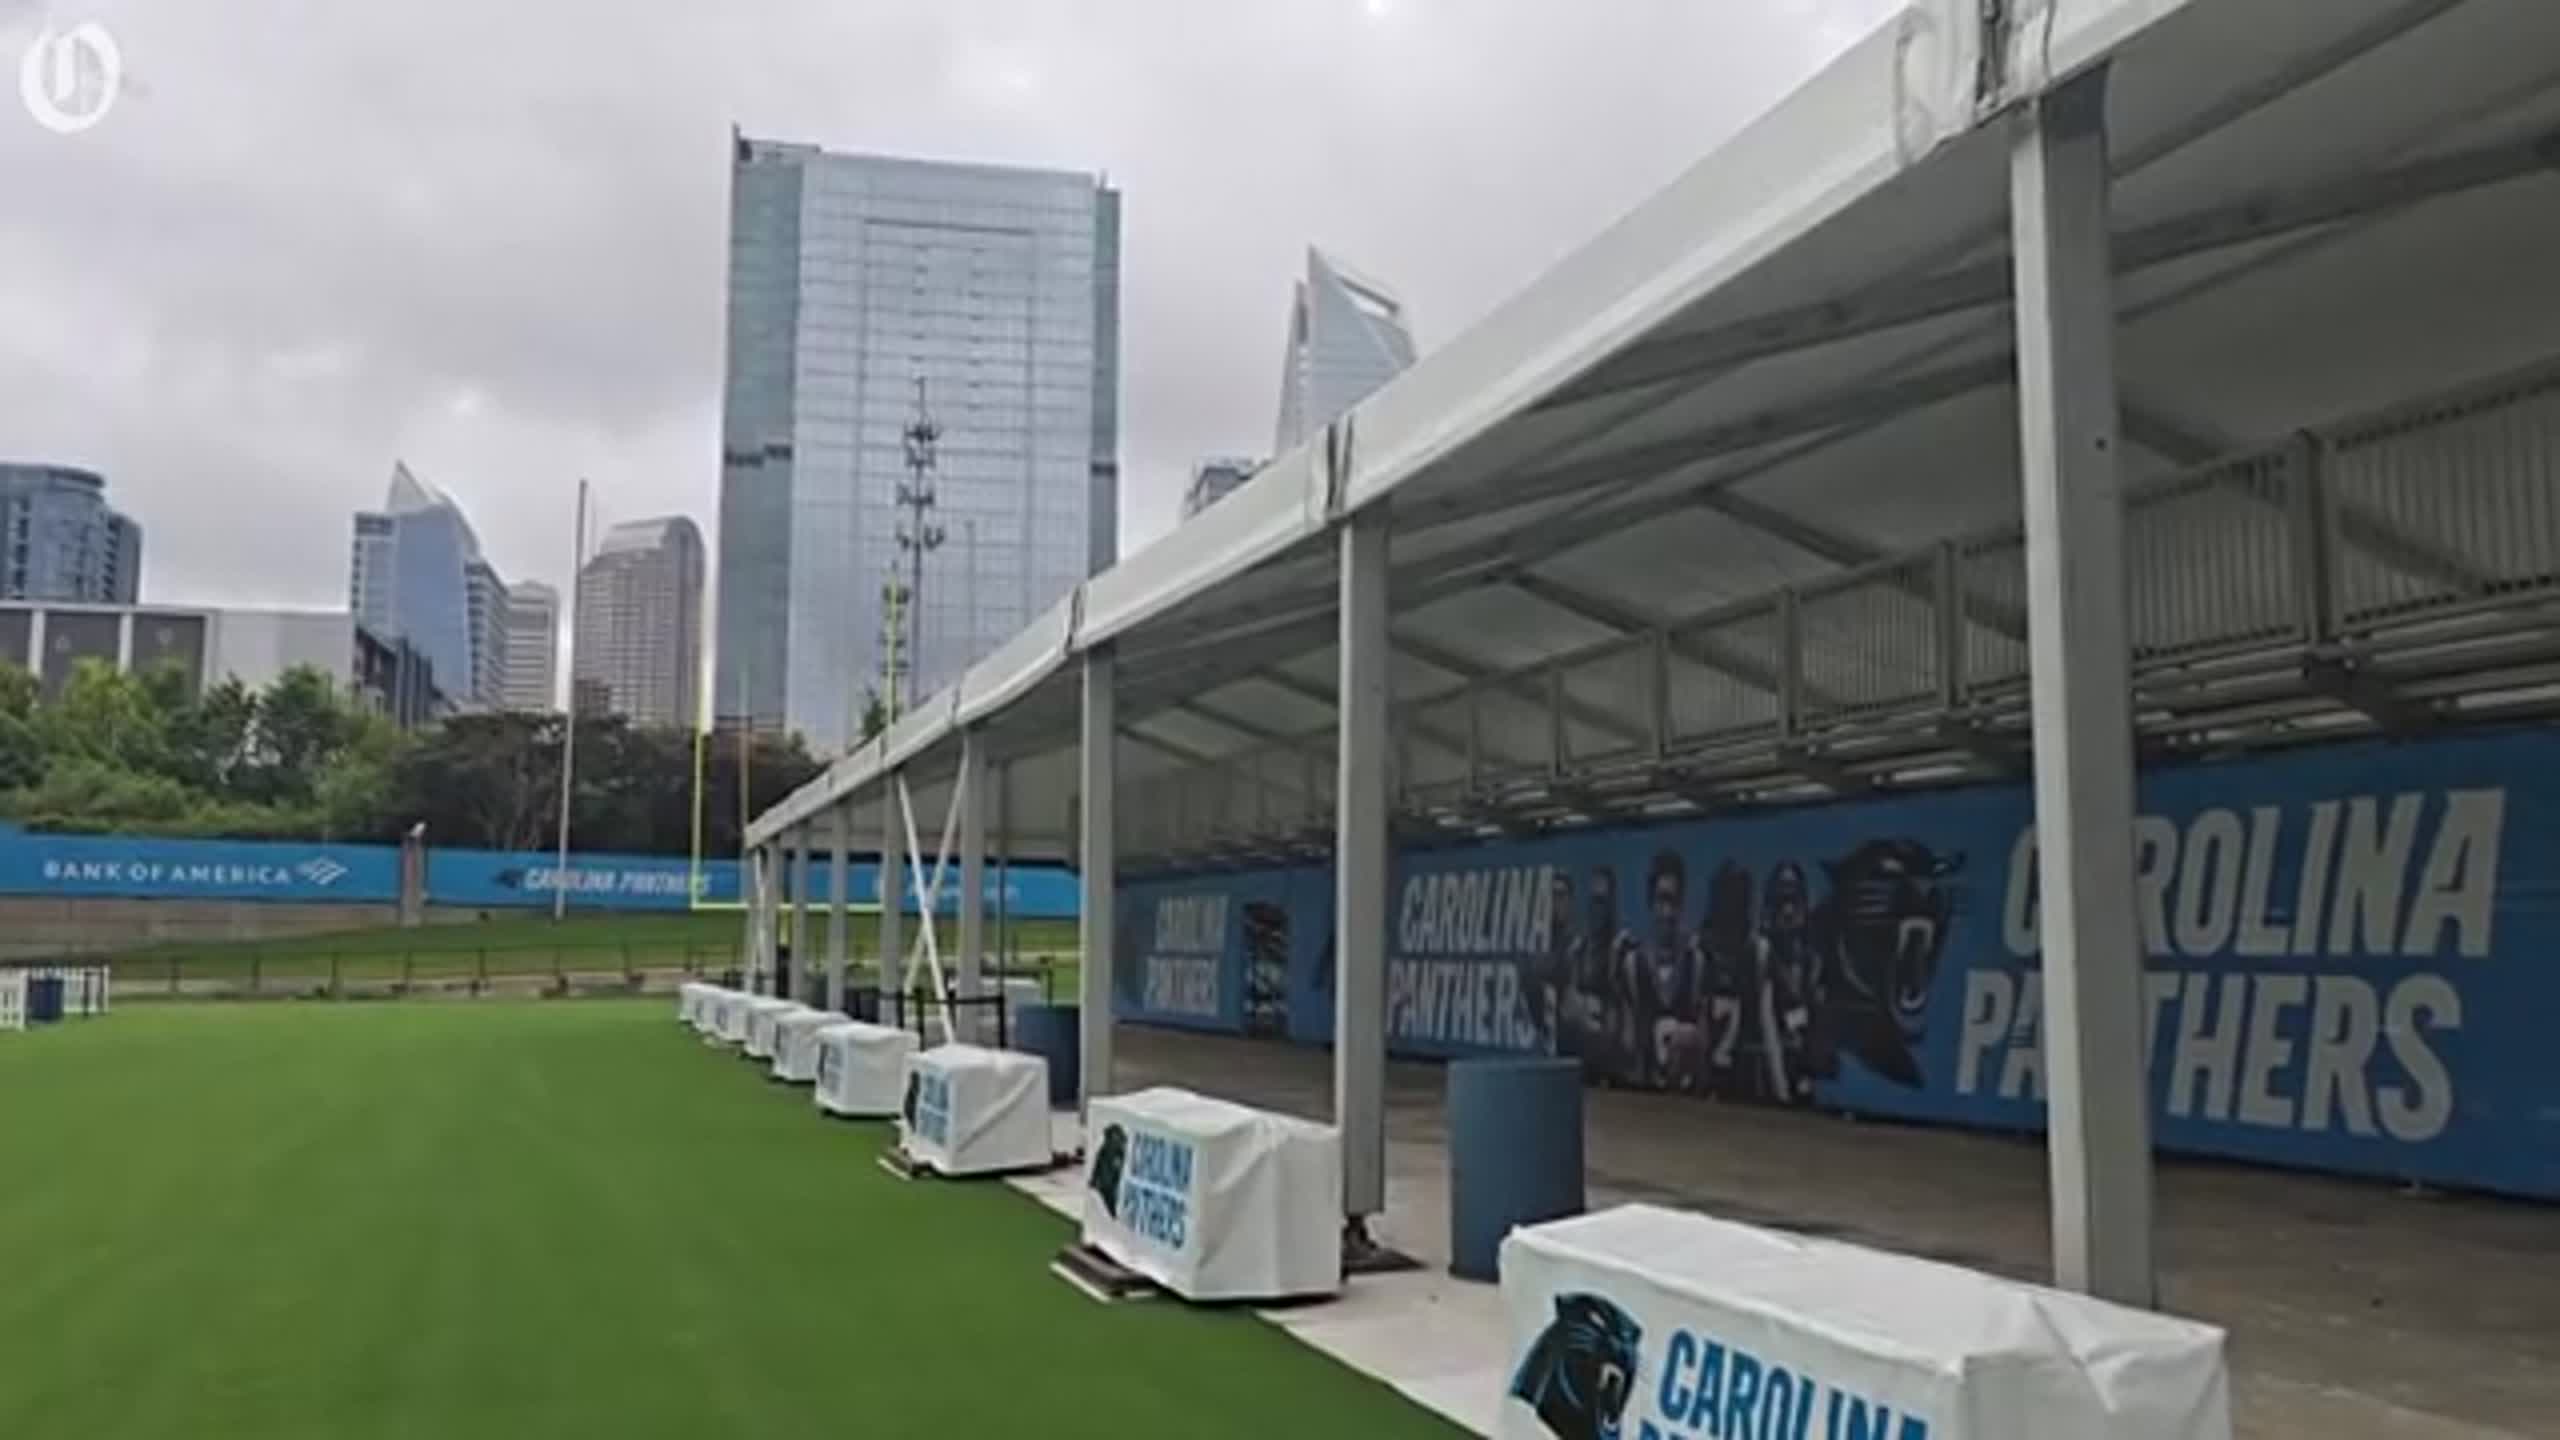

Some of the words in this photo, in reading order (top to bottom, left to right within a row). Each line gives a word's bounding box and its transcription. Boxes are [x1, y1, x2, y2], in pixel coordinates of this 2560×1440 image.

[43, 860, 121, 881] BANK
[129, 862, 164, 882] OF
[170, 863, 292, 884] AMERICA
[1401, 864, 1553, 953] CAROLINA
[2004, 787, 2506, 958] CROLINA
[1955, 968, 2462, 1142] PATHERS
[1658, 1329, 1930, 1440] CAROLIN
